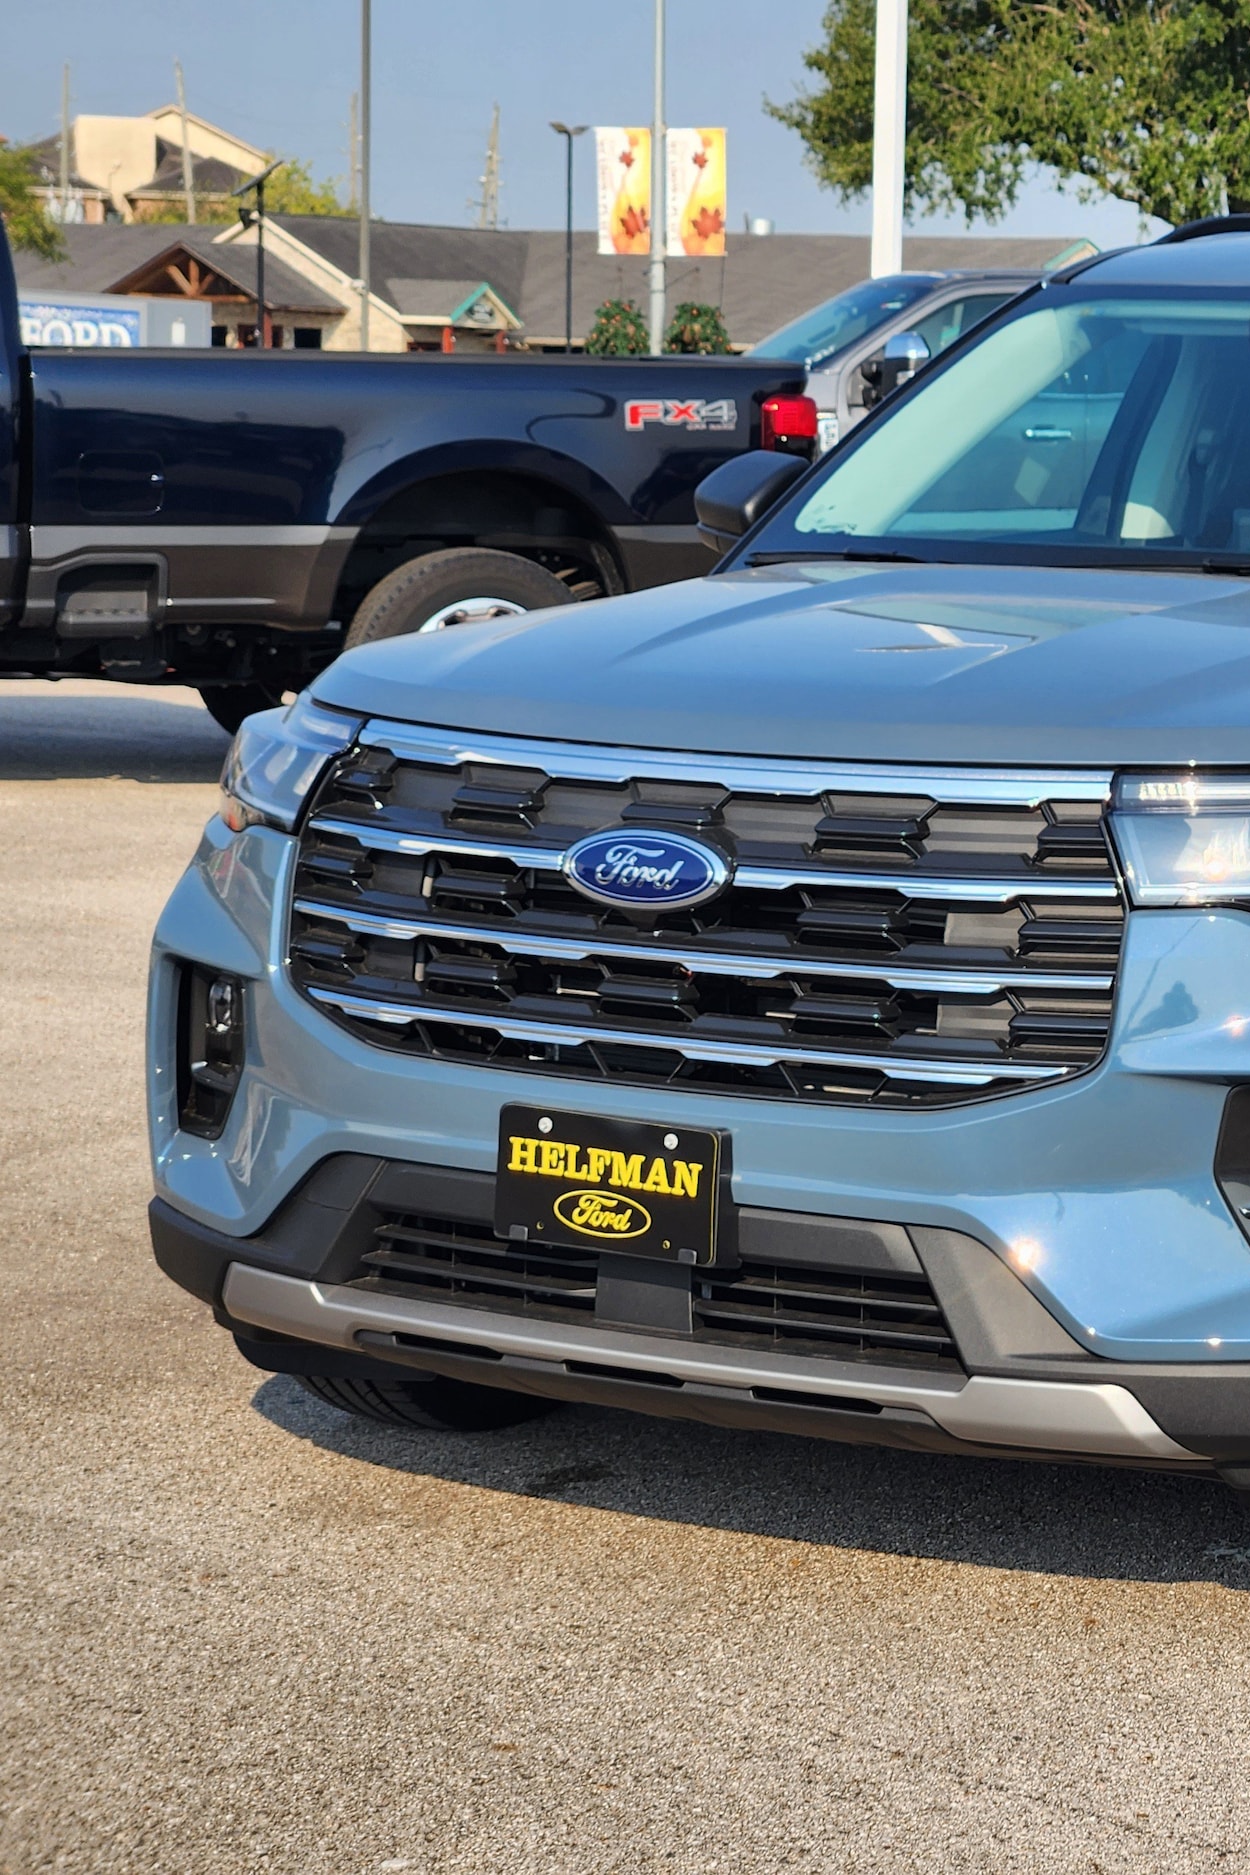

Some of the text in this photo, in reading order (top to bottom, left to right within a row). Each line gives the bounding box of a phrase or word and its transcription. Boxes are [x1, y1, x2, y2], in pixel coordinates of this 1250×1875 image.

[624, 399, 737, 431] FX4
[596, 844, 684, 891] Ford
[507, 1136, 703, 1198] HELFMAN
[571, 1194, 632, 1231] Ford
